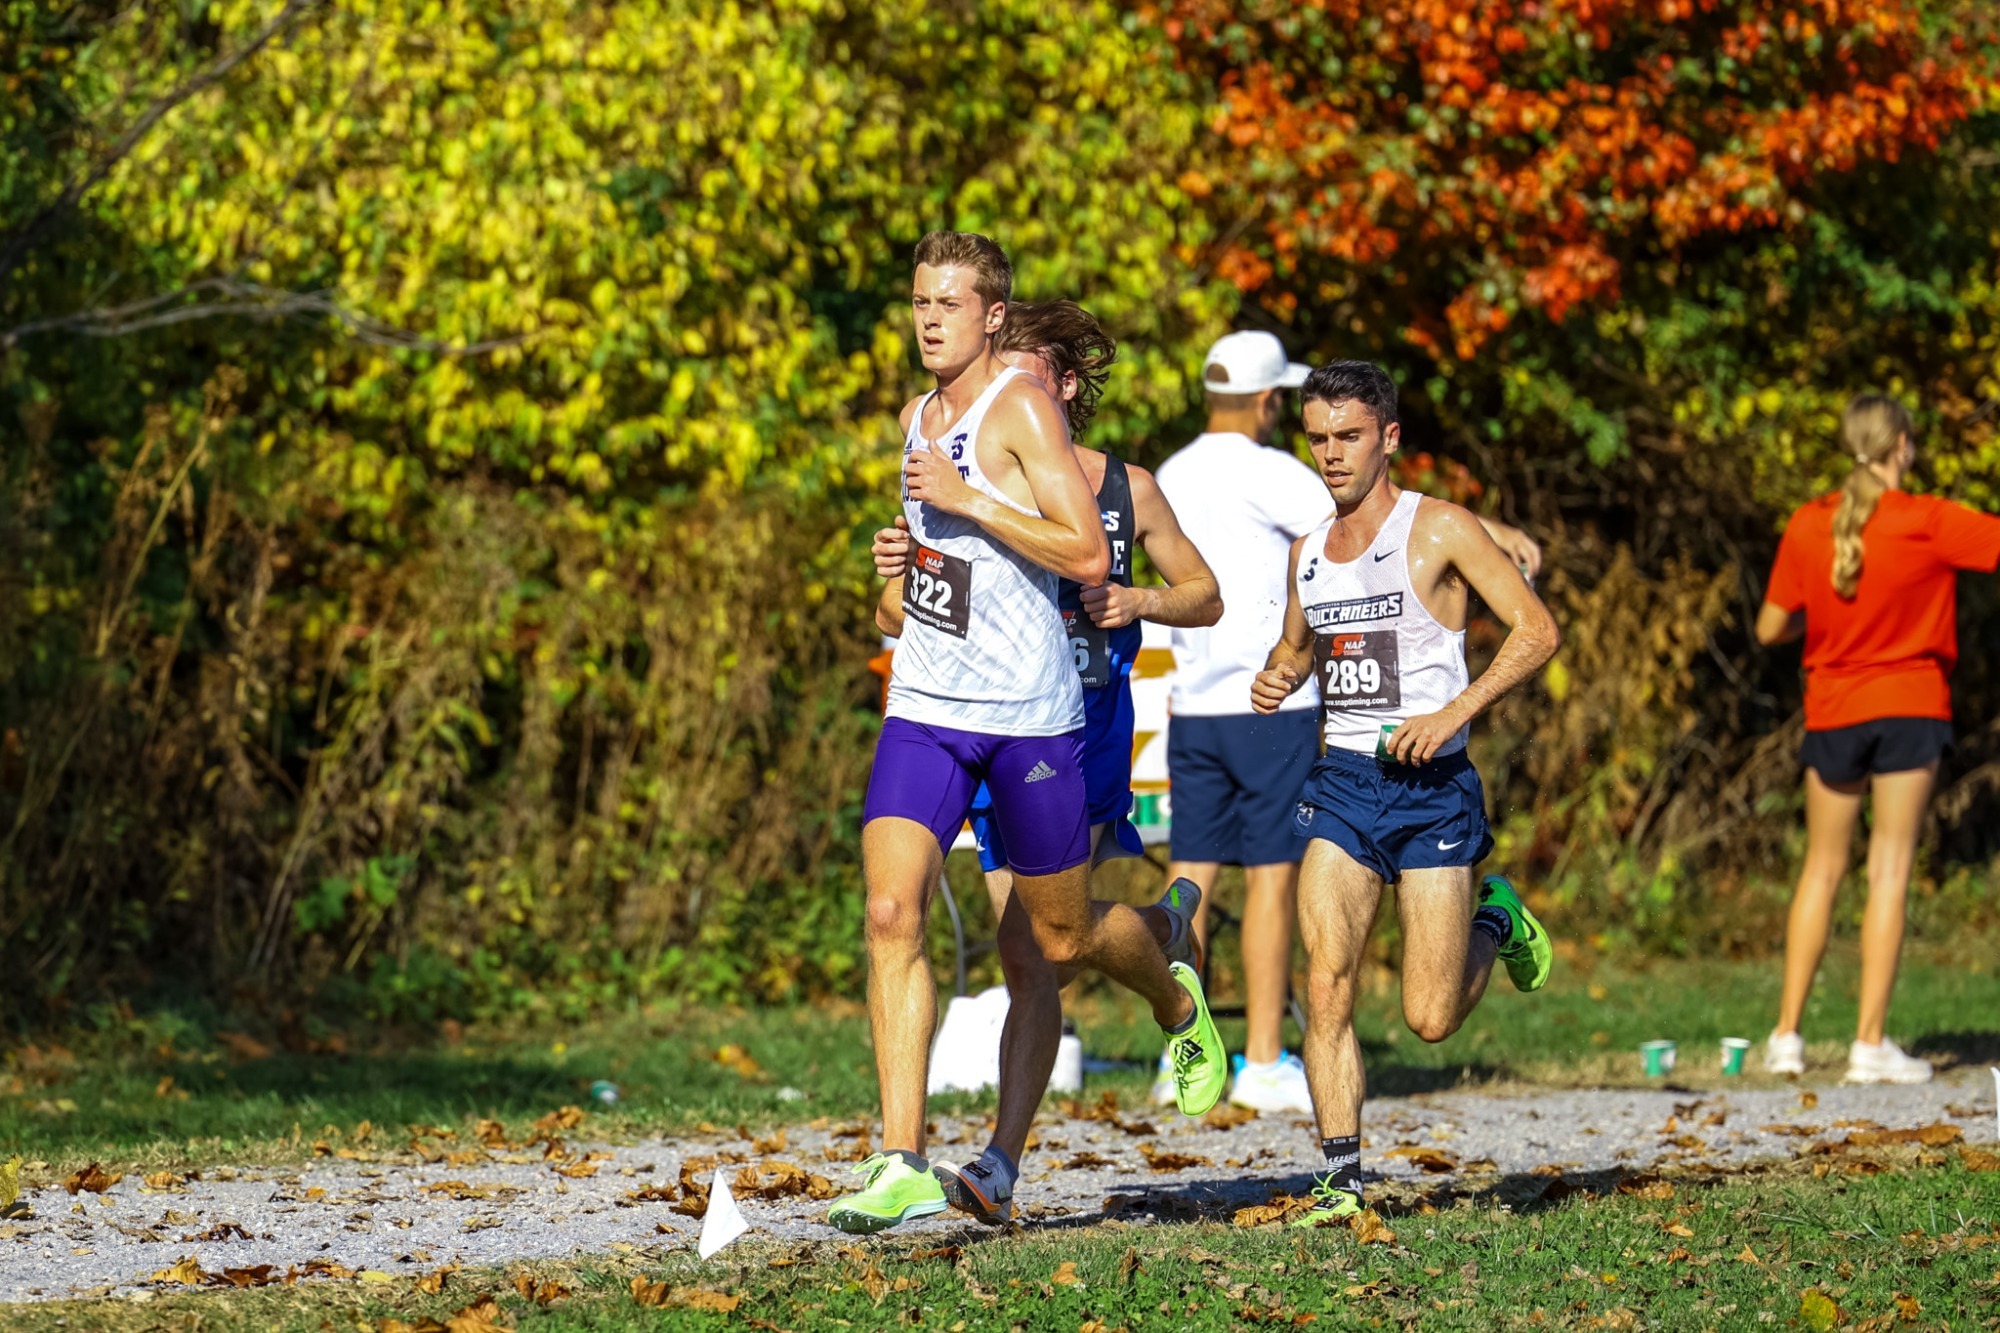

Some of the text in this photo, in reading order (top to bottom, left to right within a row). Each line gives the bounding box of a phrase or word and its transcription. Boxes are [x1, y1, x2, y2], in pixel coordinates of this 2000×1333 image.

[916, 547, 944, 570] SNAP
[910, 566, 952, 617] 322
[1306, 594, 1401, 628] BUCCANEERS
[1331, 634, 1366, 656] SNAP
[1325, 658, 1381, 695] 289
